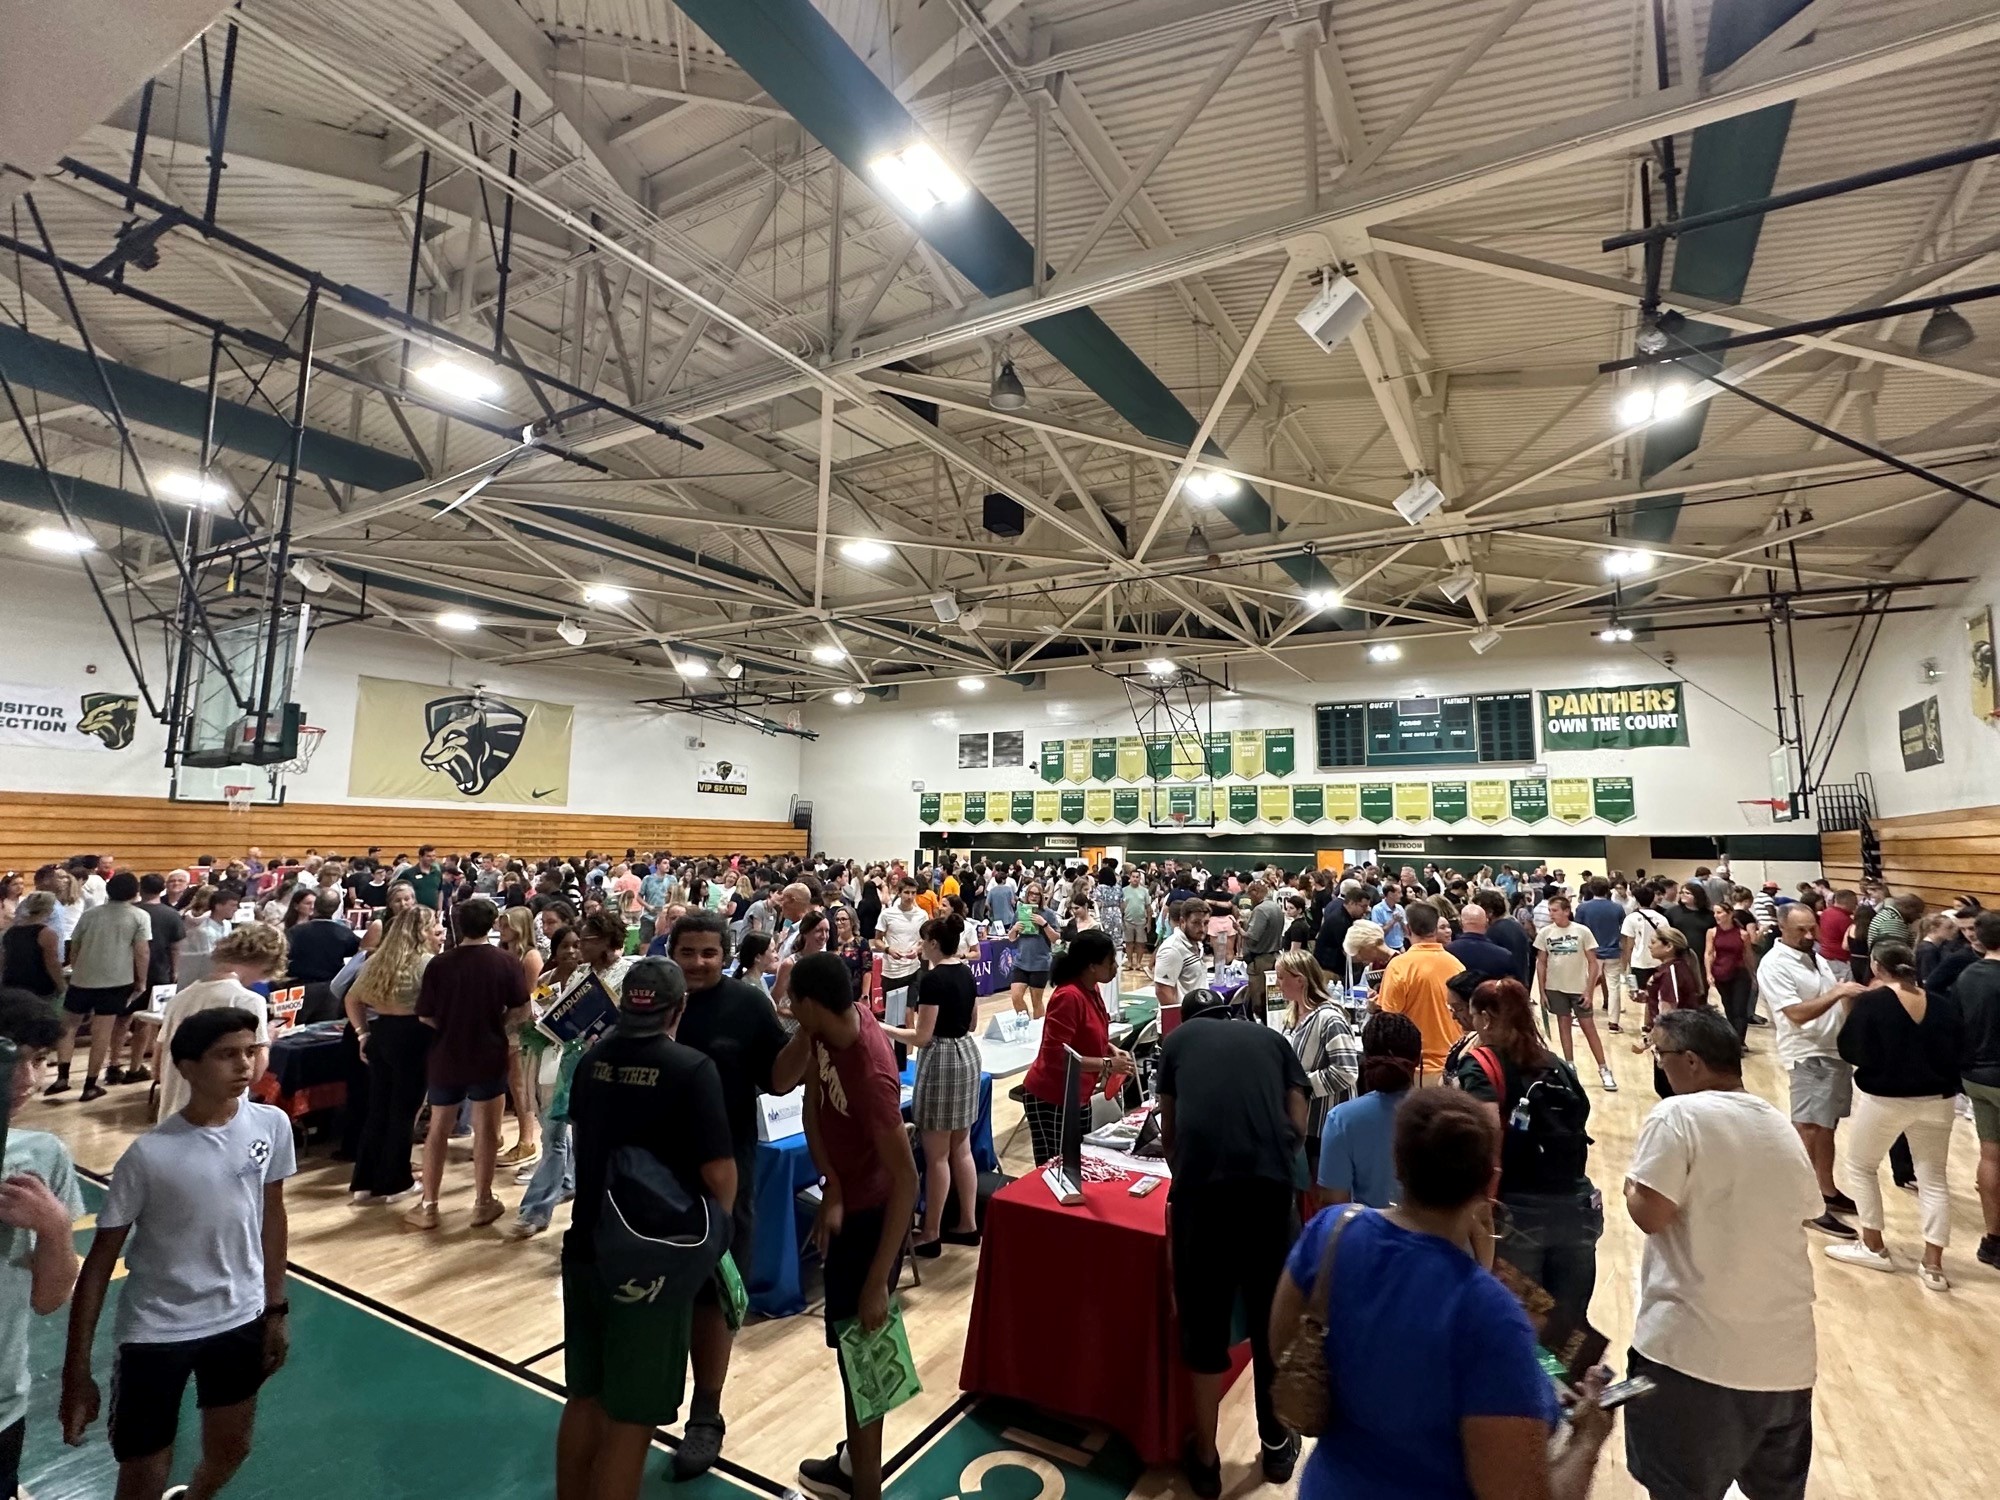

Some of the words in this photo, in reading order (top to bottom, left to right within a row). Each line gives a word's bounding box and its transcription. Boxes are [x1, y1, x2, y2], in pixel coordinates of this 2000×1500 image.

[1547, 688, 1676, 716] PANTHERS
[1548, 718, 1587, 733] OWN
[1591, 716, 1621, 732] THE
[1624, 713, 1679, 730] COURT
[699, 783, 712, 791] VIP
[713, 784, 746, 793] SEATING
[276, 1001, 302, 1012] WAHOOS
[552, 980, 593, 1021] DEADLINES
